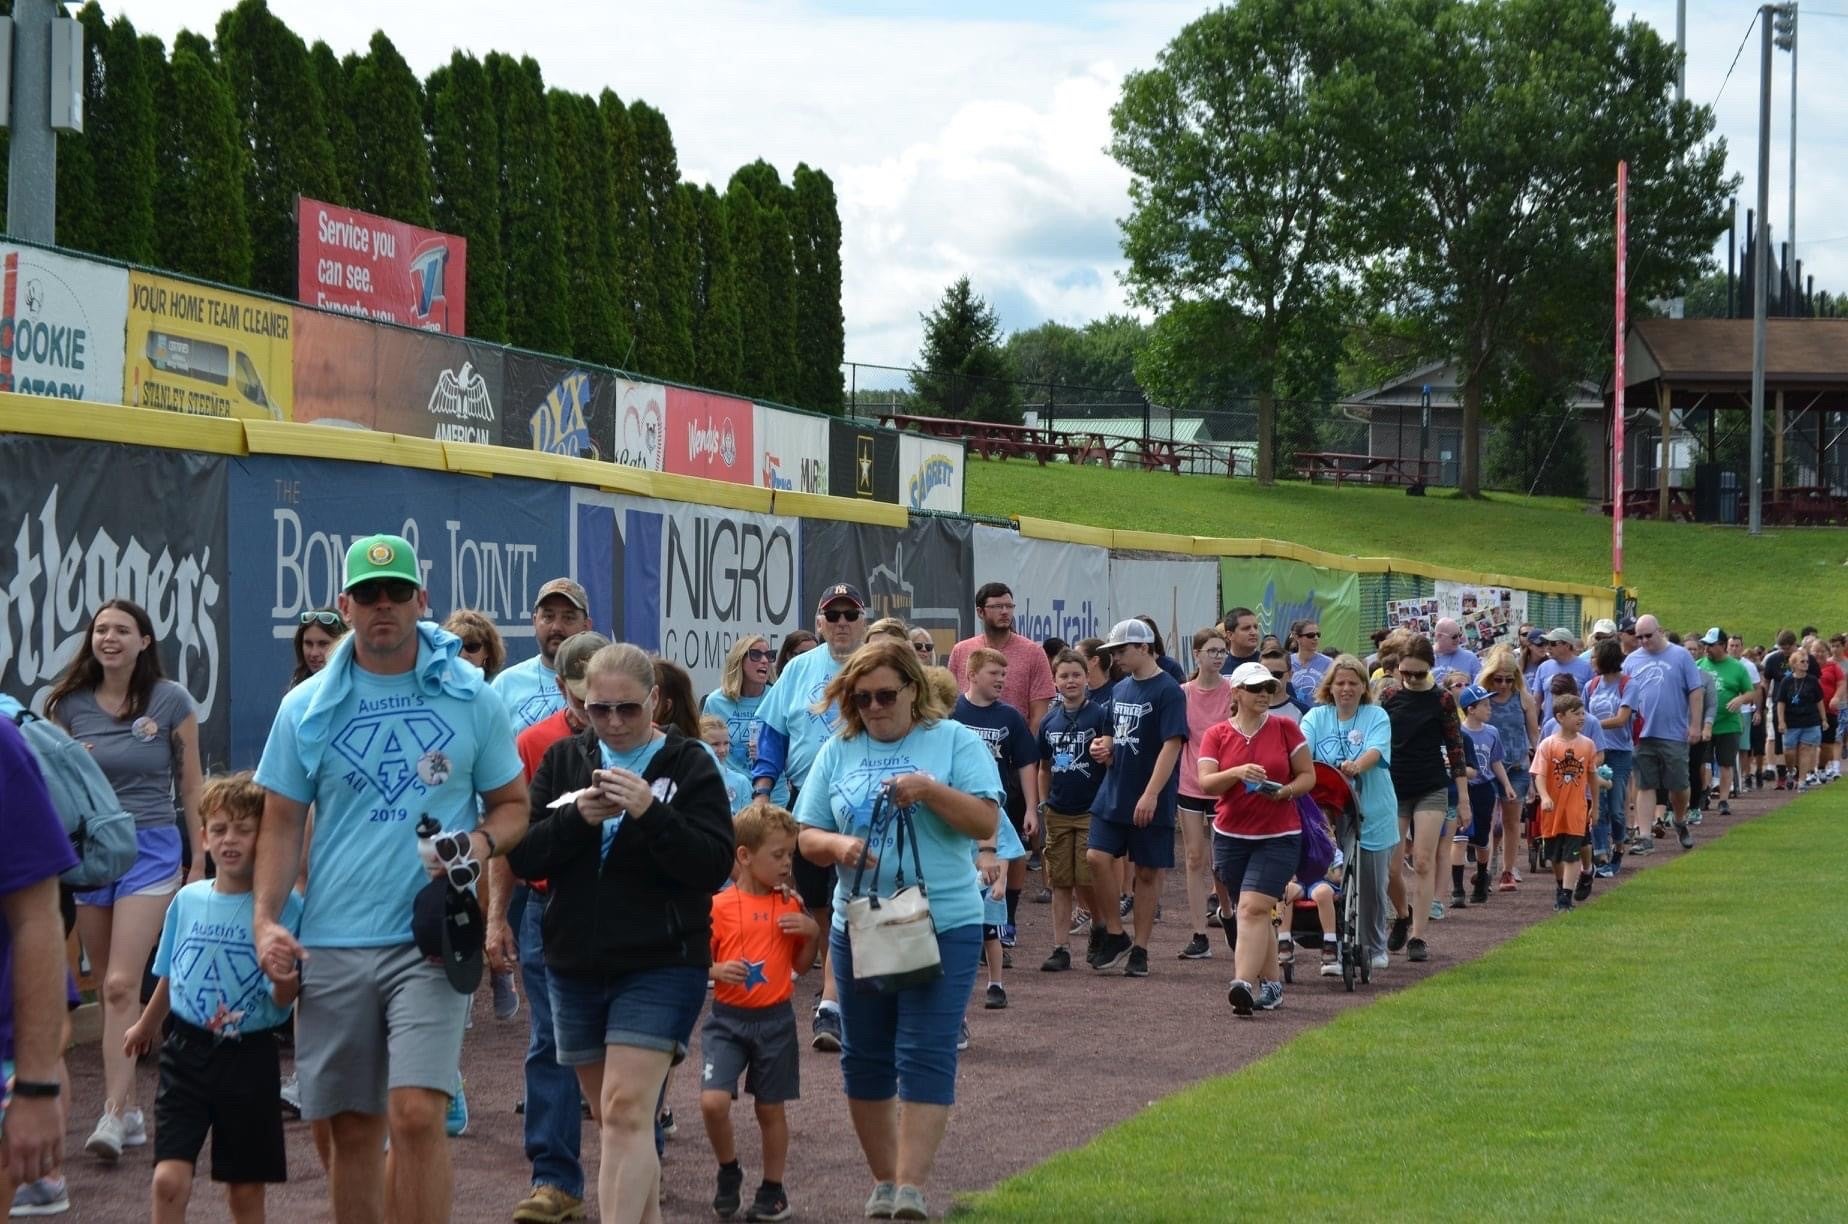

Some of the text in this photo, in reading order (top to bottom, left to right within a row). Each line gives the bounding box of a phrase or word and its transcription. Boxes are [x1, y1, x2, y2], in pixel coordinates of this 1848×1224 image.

[318, 210, 395, 261] Service you
[318, 258, 374, 293] can see.
[132, 283, 289, 340] YOUR HOME TEAM CLEANER
[142, 381, 231, 417] STANLEY STEEMER
[688, 416, 720, 465] Wendy's
[274, 479, 301, 505] THE
[446, 519, 537, 620] JOINT
[666, 514, 794, 626] NIGRO
[358, 693, 425, 713] Austin's
[860, 754, 910, 767] Austin's
[369, 807, 408, 823] 2019
[190, 919, 248, 940] Austin's
